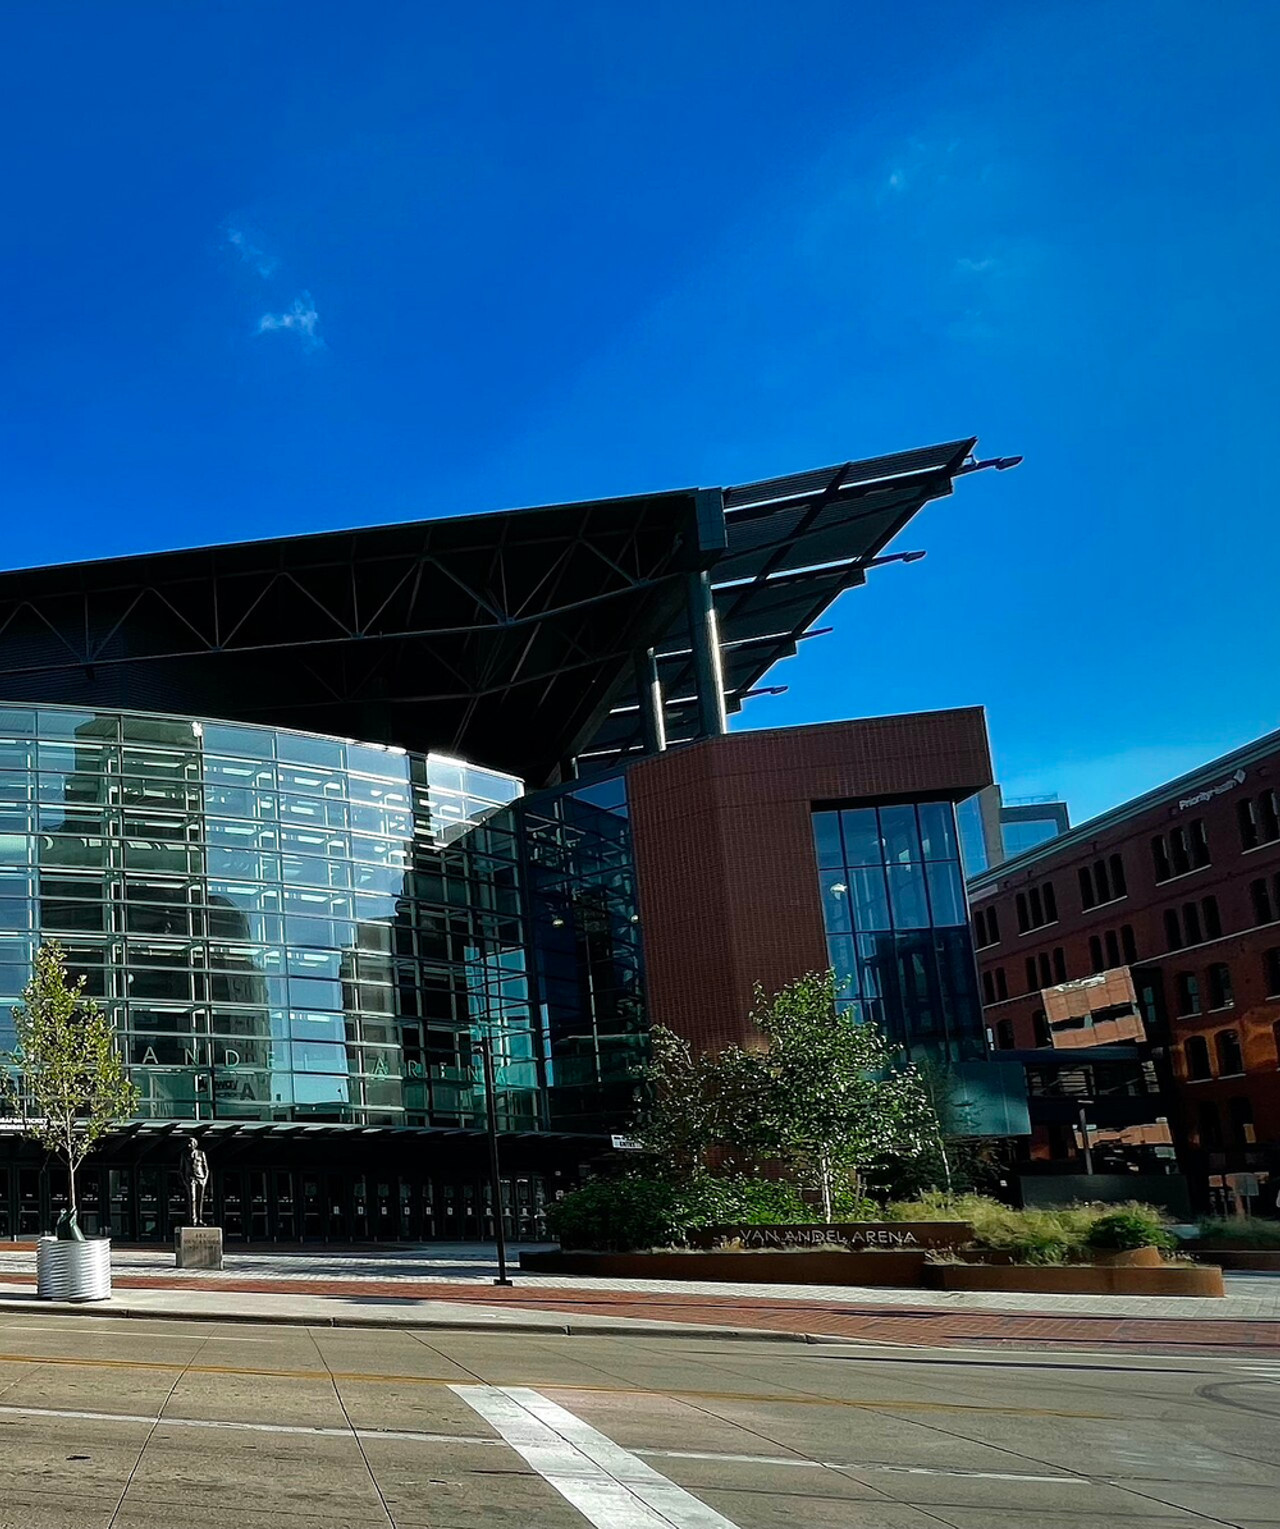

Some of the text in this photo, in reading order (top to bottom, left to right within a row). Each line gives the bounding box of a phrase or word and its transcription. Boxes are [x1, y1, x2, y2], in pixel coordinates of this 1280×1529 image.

[371, 1056, 508, 1084] ARENA
[740, 1229, 919, 1244] VAN ANDEL ARENA
